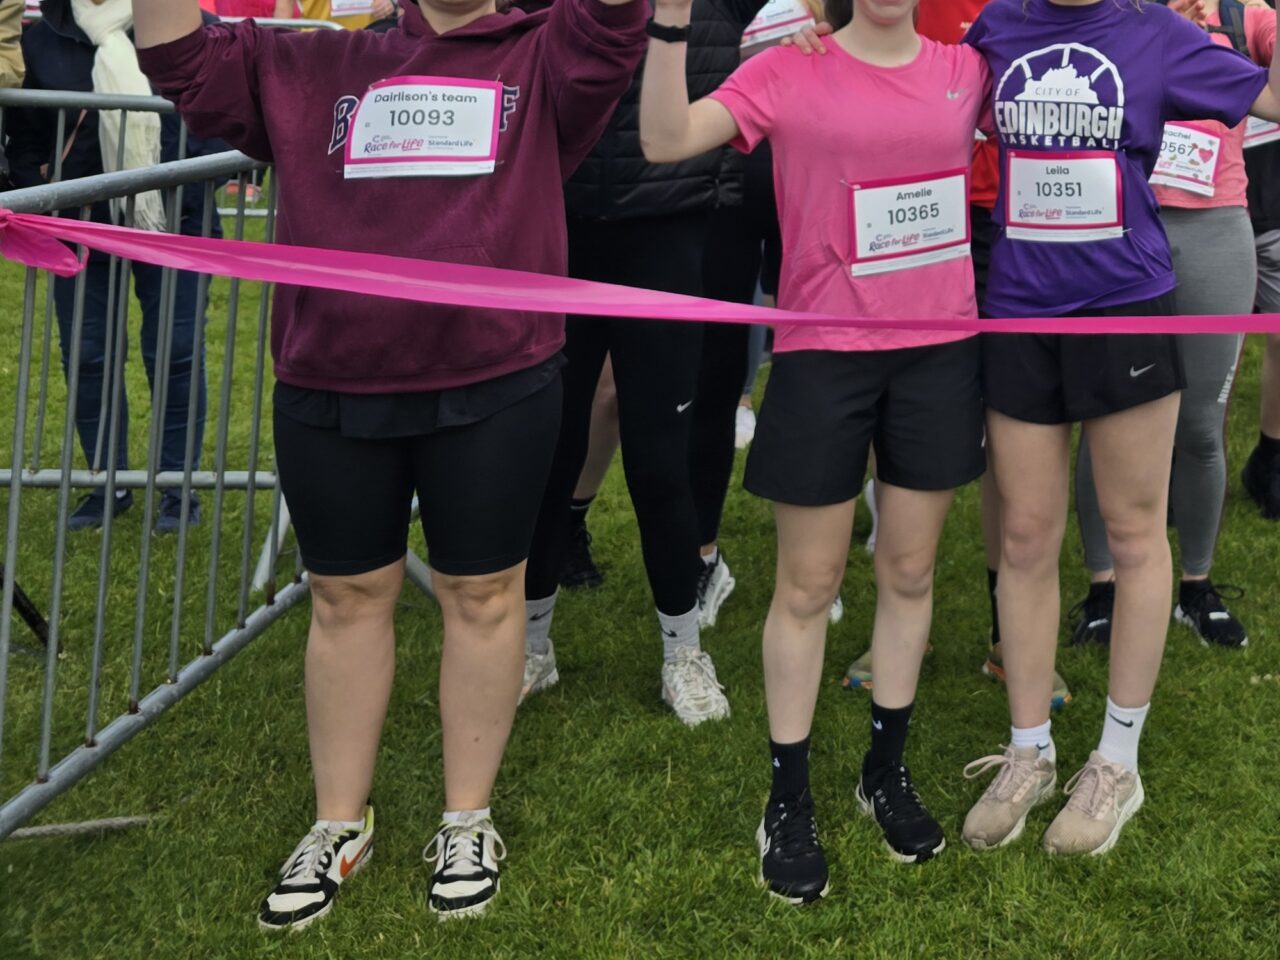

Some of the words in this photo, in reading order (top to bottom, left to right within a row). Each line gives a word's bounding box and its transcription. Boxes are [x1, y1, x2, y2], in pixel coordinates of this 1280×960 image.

[374, 90, 438, 103] Dairlison's
[442, 92, 478, 103] team
[1035, 87, 1061, 96] CITY
[1066, 88, 1080, 96] OF
[389, 109, 455, 127] 10093
[995, 101, 1124, 139] EDINBURGH
[1164, 130, 1191, 139] achel
[364, 139, 388, 153] Race
[389, 140, 401, 150] for
[401, 138, 424, 151] Life
[428, 139, 460, 147] Standard
[460, 139, 473, 147] Life
[1160, 140, 1196, 156] 0567
[1046, 166, 1070, 175] Leila
[896, 187, 932, 201] Amelie
[1036, 182, 1082, 197] 10351
[888, 203, 940, 225] 10365
